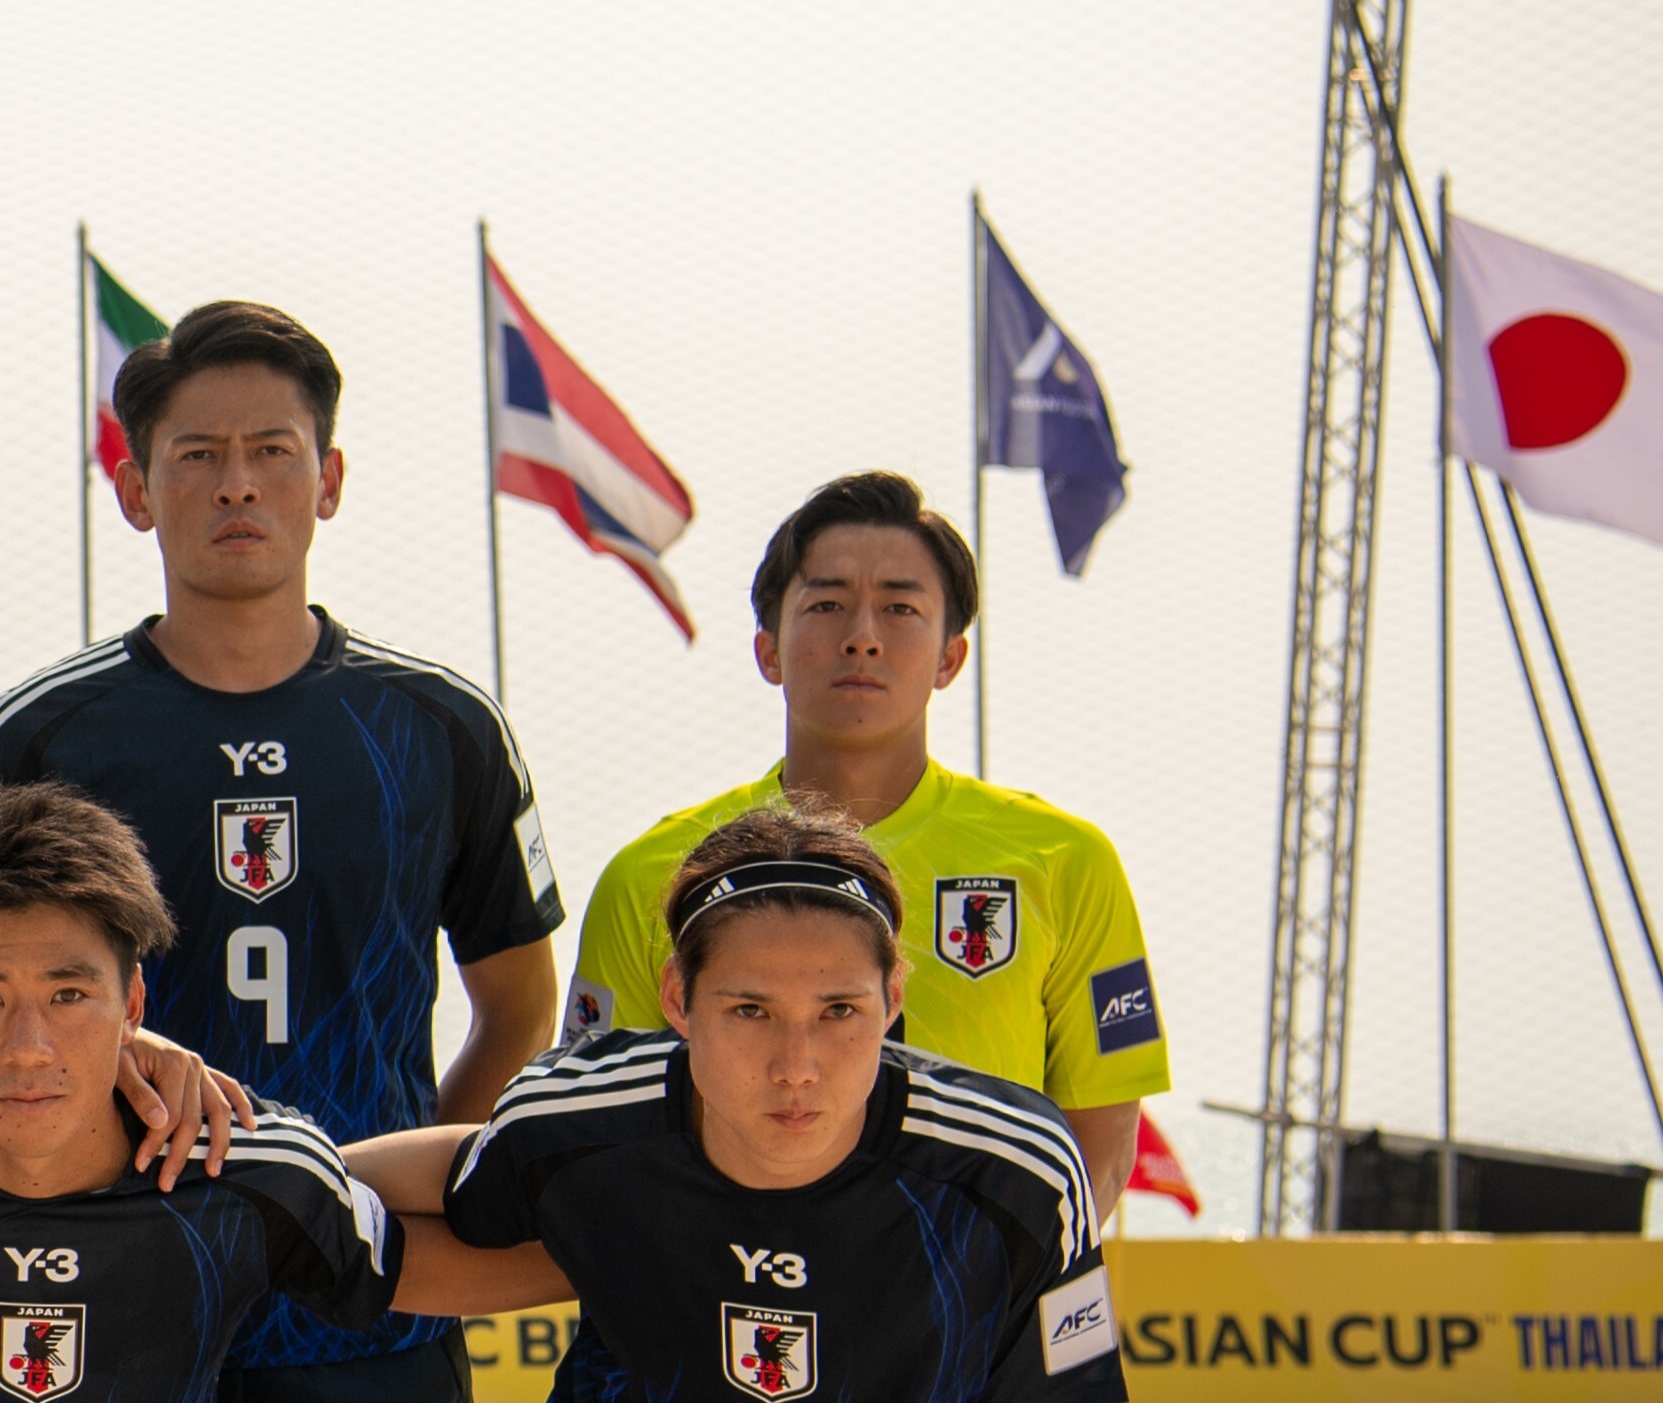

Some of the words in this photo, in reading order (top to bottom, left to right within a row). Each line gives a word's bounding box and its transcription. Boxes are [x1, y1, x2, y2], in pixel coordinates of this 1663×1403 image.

[220, 742, 287, 777] Y-3
[234, 802, 277, 813] JAPAN
[239, 867, 274, 884] JFA
[955, 877, 1001, 890] JAPAN
[957, 945, 995, 963] JFA
[227, 925, 287, 1044] 9
[1101, 989, 1147, 1022] AFC
[4, 1248, 79, 1283] Y-3
[730, 1244, 808, 1287] Y-3
[17, 1306, 64, 1318] JAPAN
[746, 1310, 795, 1324] JAPAN
[1052, 1299, 1102, 1339] AFC
[1329, 1314, 1480, 1368] CUP
[17, 1371, 57, 1389] JFA
[751, 1370, 791, 1391] JFA
